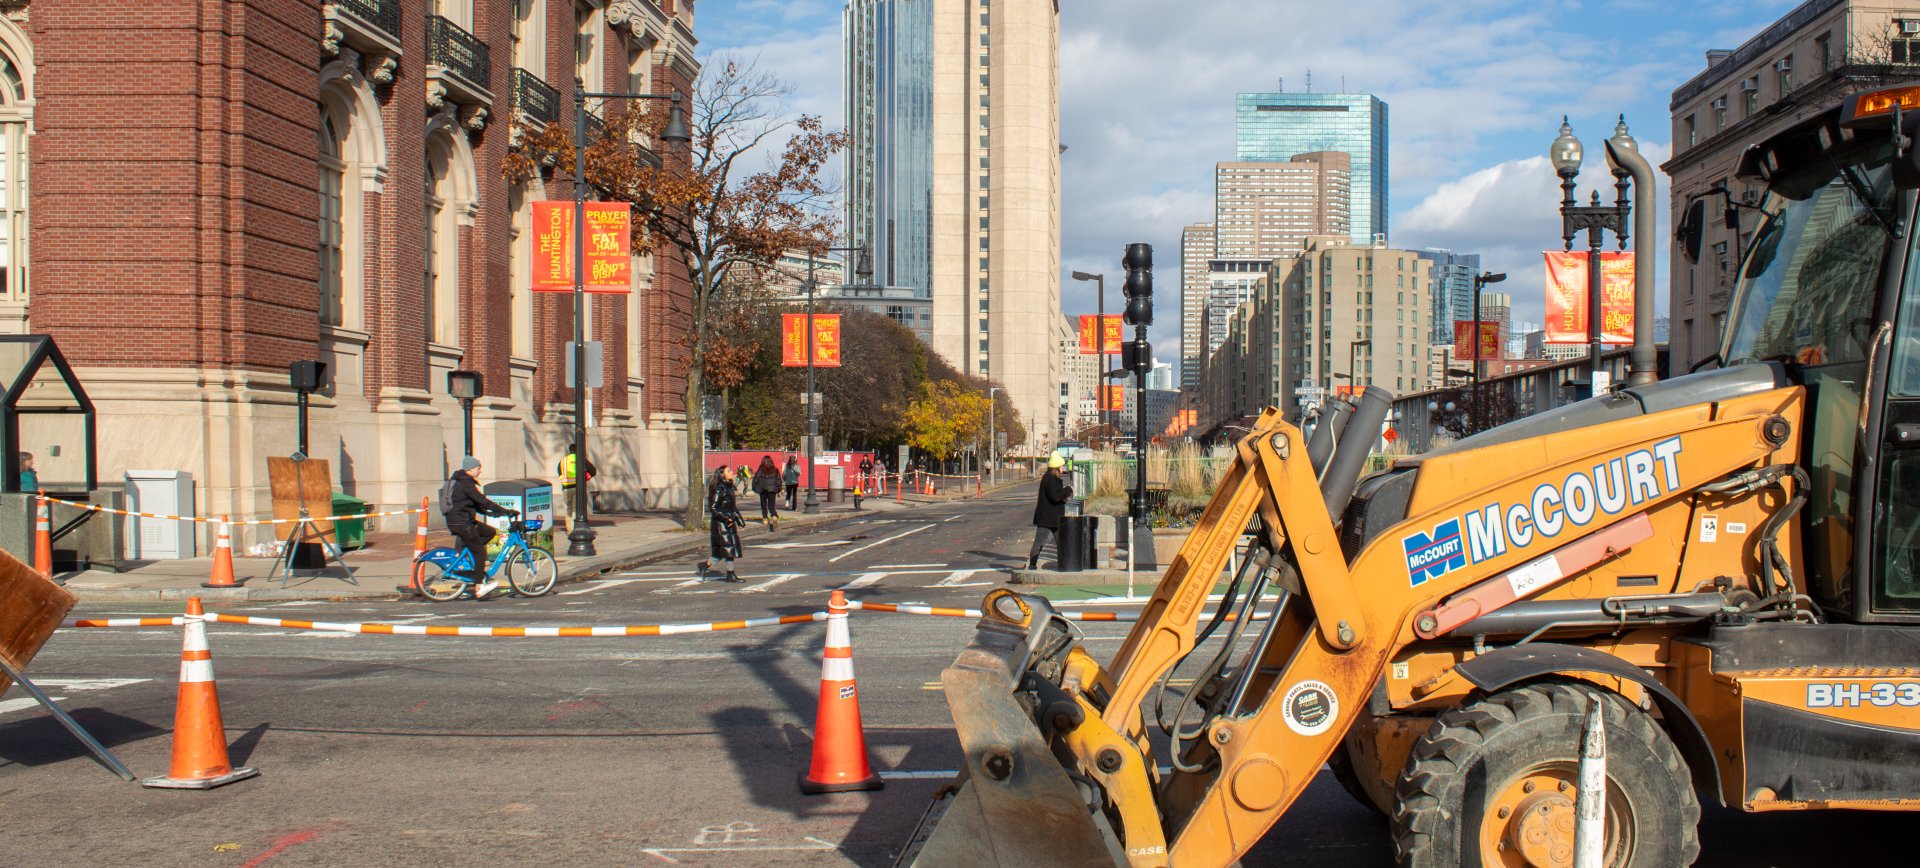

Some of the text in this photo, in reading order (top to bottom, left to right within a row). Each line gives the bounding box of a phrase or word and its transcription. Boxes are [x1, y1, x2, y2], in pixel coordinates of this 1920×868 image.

[586, 211, 627, 219] PRAYER
[551, 208, 561, 279] HUNTINGTON
[592, 232, 618, 244] FAT
[541, 234, 550, 254] THE
[596, 242, 619, 251] HAM
[592, 263, 625, 272] BAND'S
[1601, 260, 1633, 269] PRAYE
[592, 270, 615, 280] VISIT
[1606, 281, 1629, 294] FAT
[1564, 258, 1573, 330] HUNTINGTON
[1610, 292, 1632, 302] HAM
[1606, 313, 1634, 322] BAND'
[1465, 435, 1682, 565] McCOURT
[1409, 537, 1460, 568] McCOURT
[1298, 692, 1317, 702] CASE
[1323, 687, 1335, 703] SERVICE
[1806, 682, 1920, 707] BH-33
[1130, 846, 1164, 856] CASE
